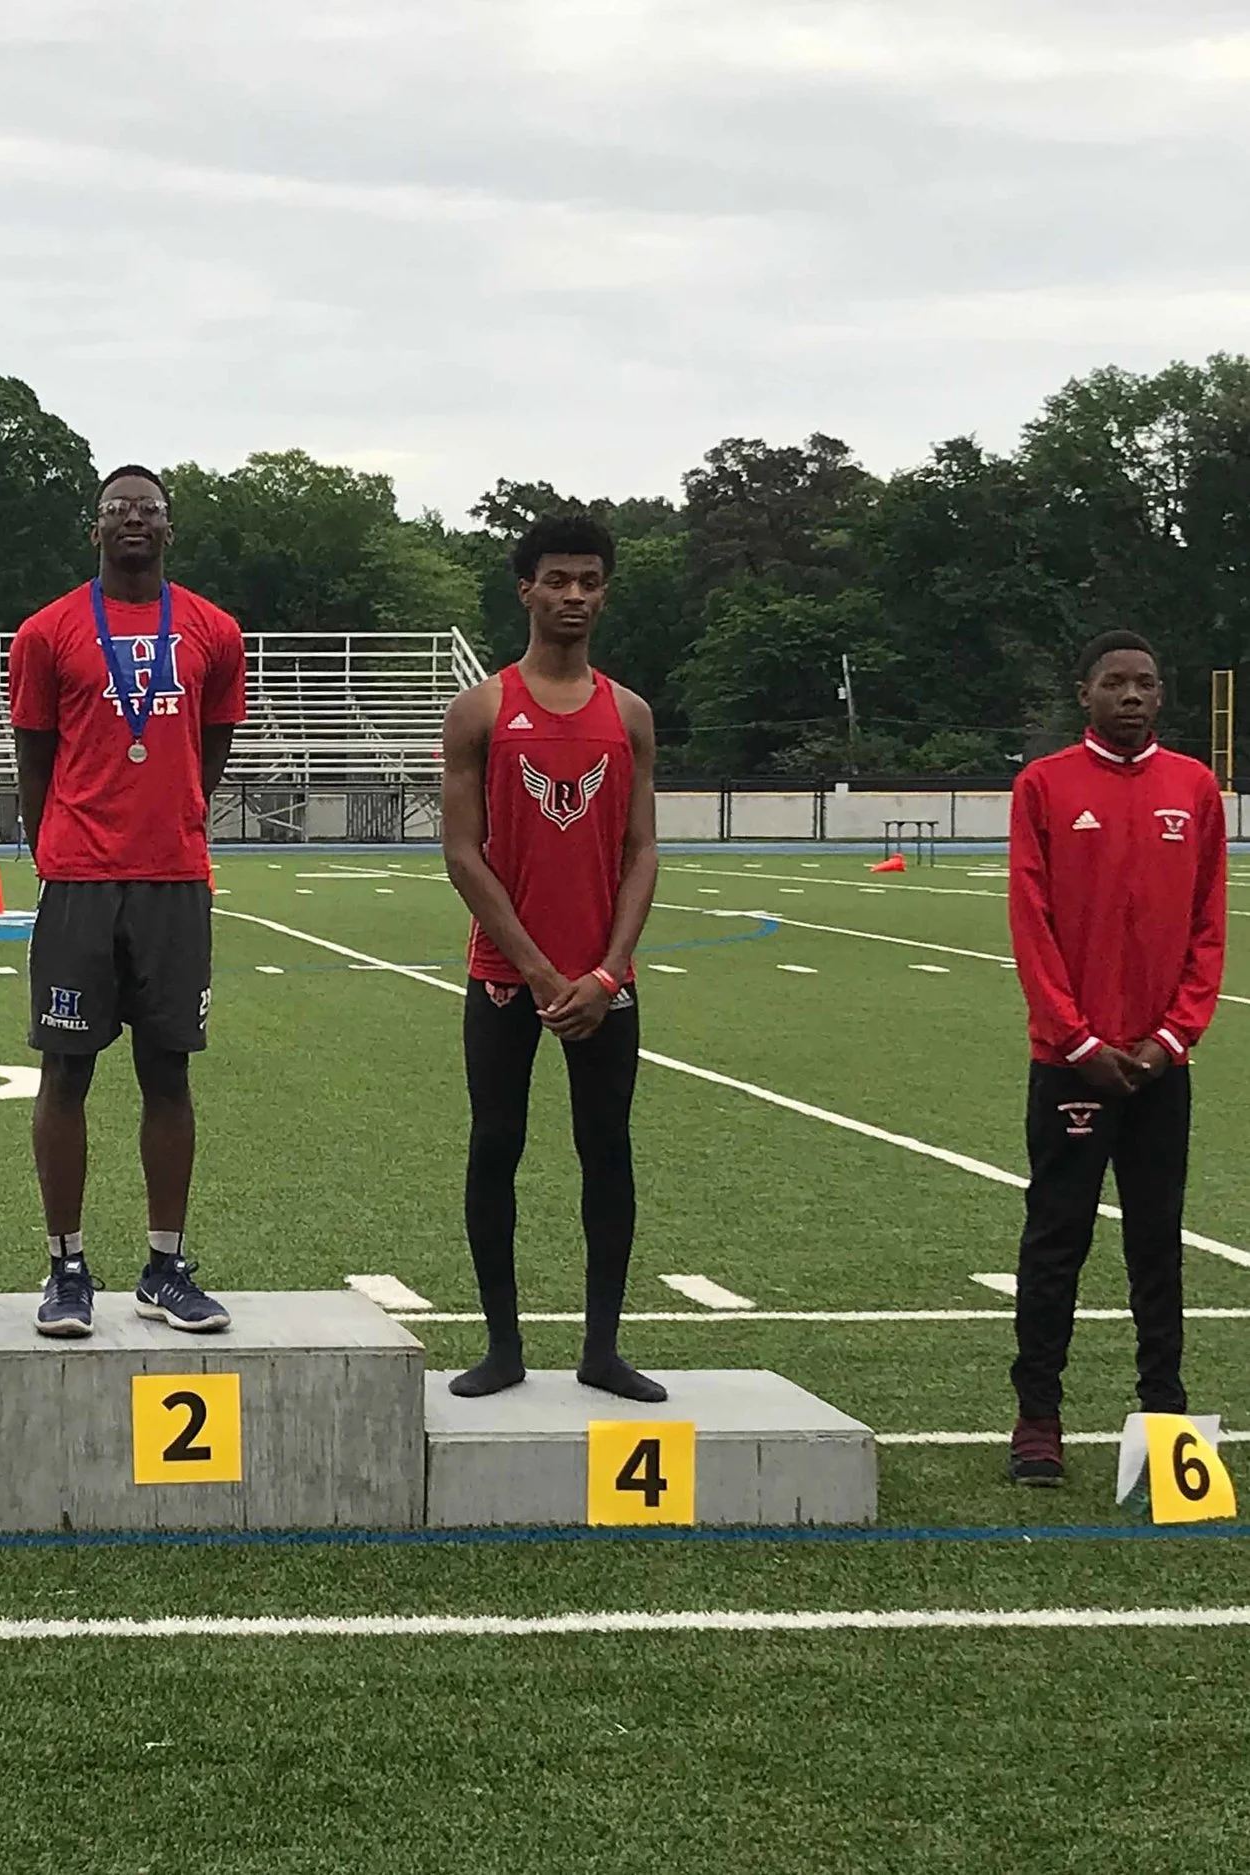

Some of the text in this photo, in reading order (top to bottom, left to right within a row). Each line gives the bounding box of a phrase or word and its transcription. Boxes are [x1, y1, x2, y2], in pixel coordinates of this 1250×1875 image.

[96, 633, 185, 698] H
[113, 697, 179, 716] TRCK
[552, 779, 575, 813] R
[50, 986, 82, 1019] H
[161, 1390, 211, 1461] 2
[615, 1438, 668, 1508] 4
[1173, 1431, 1211, 1502] 6
